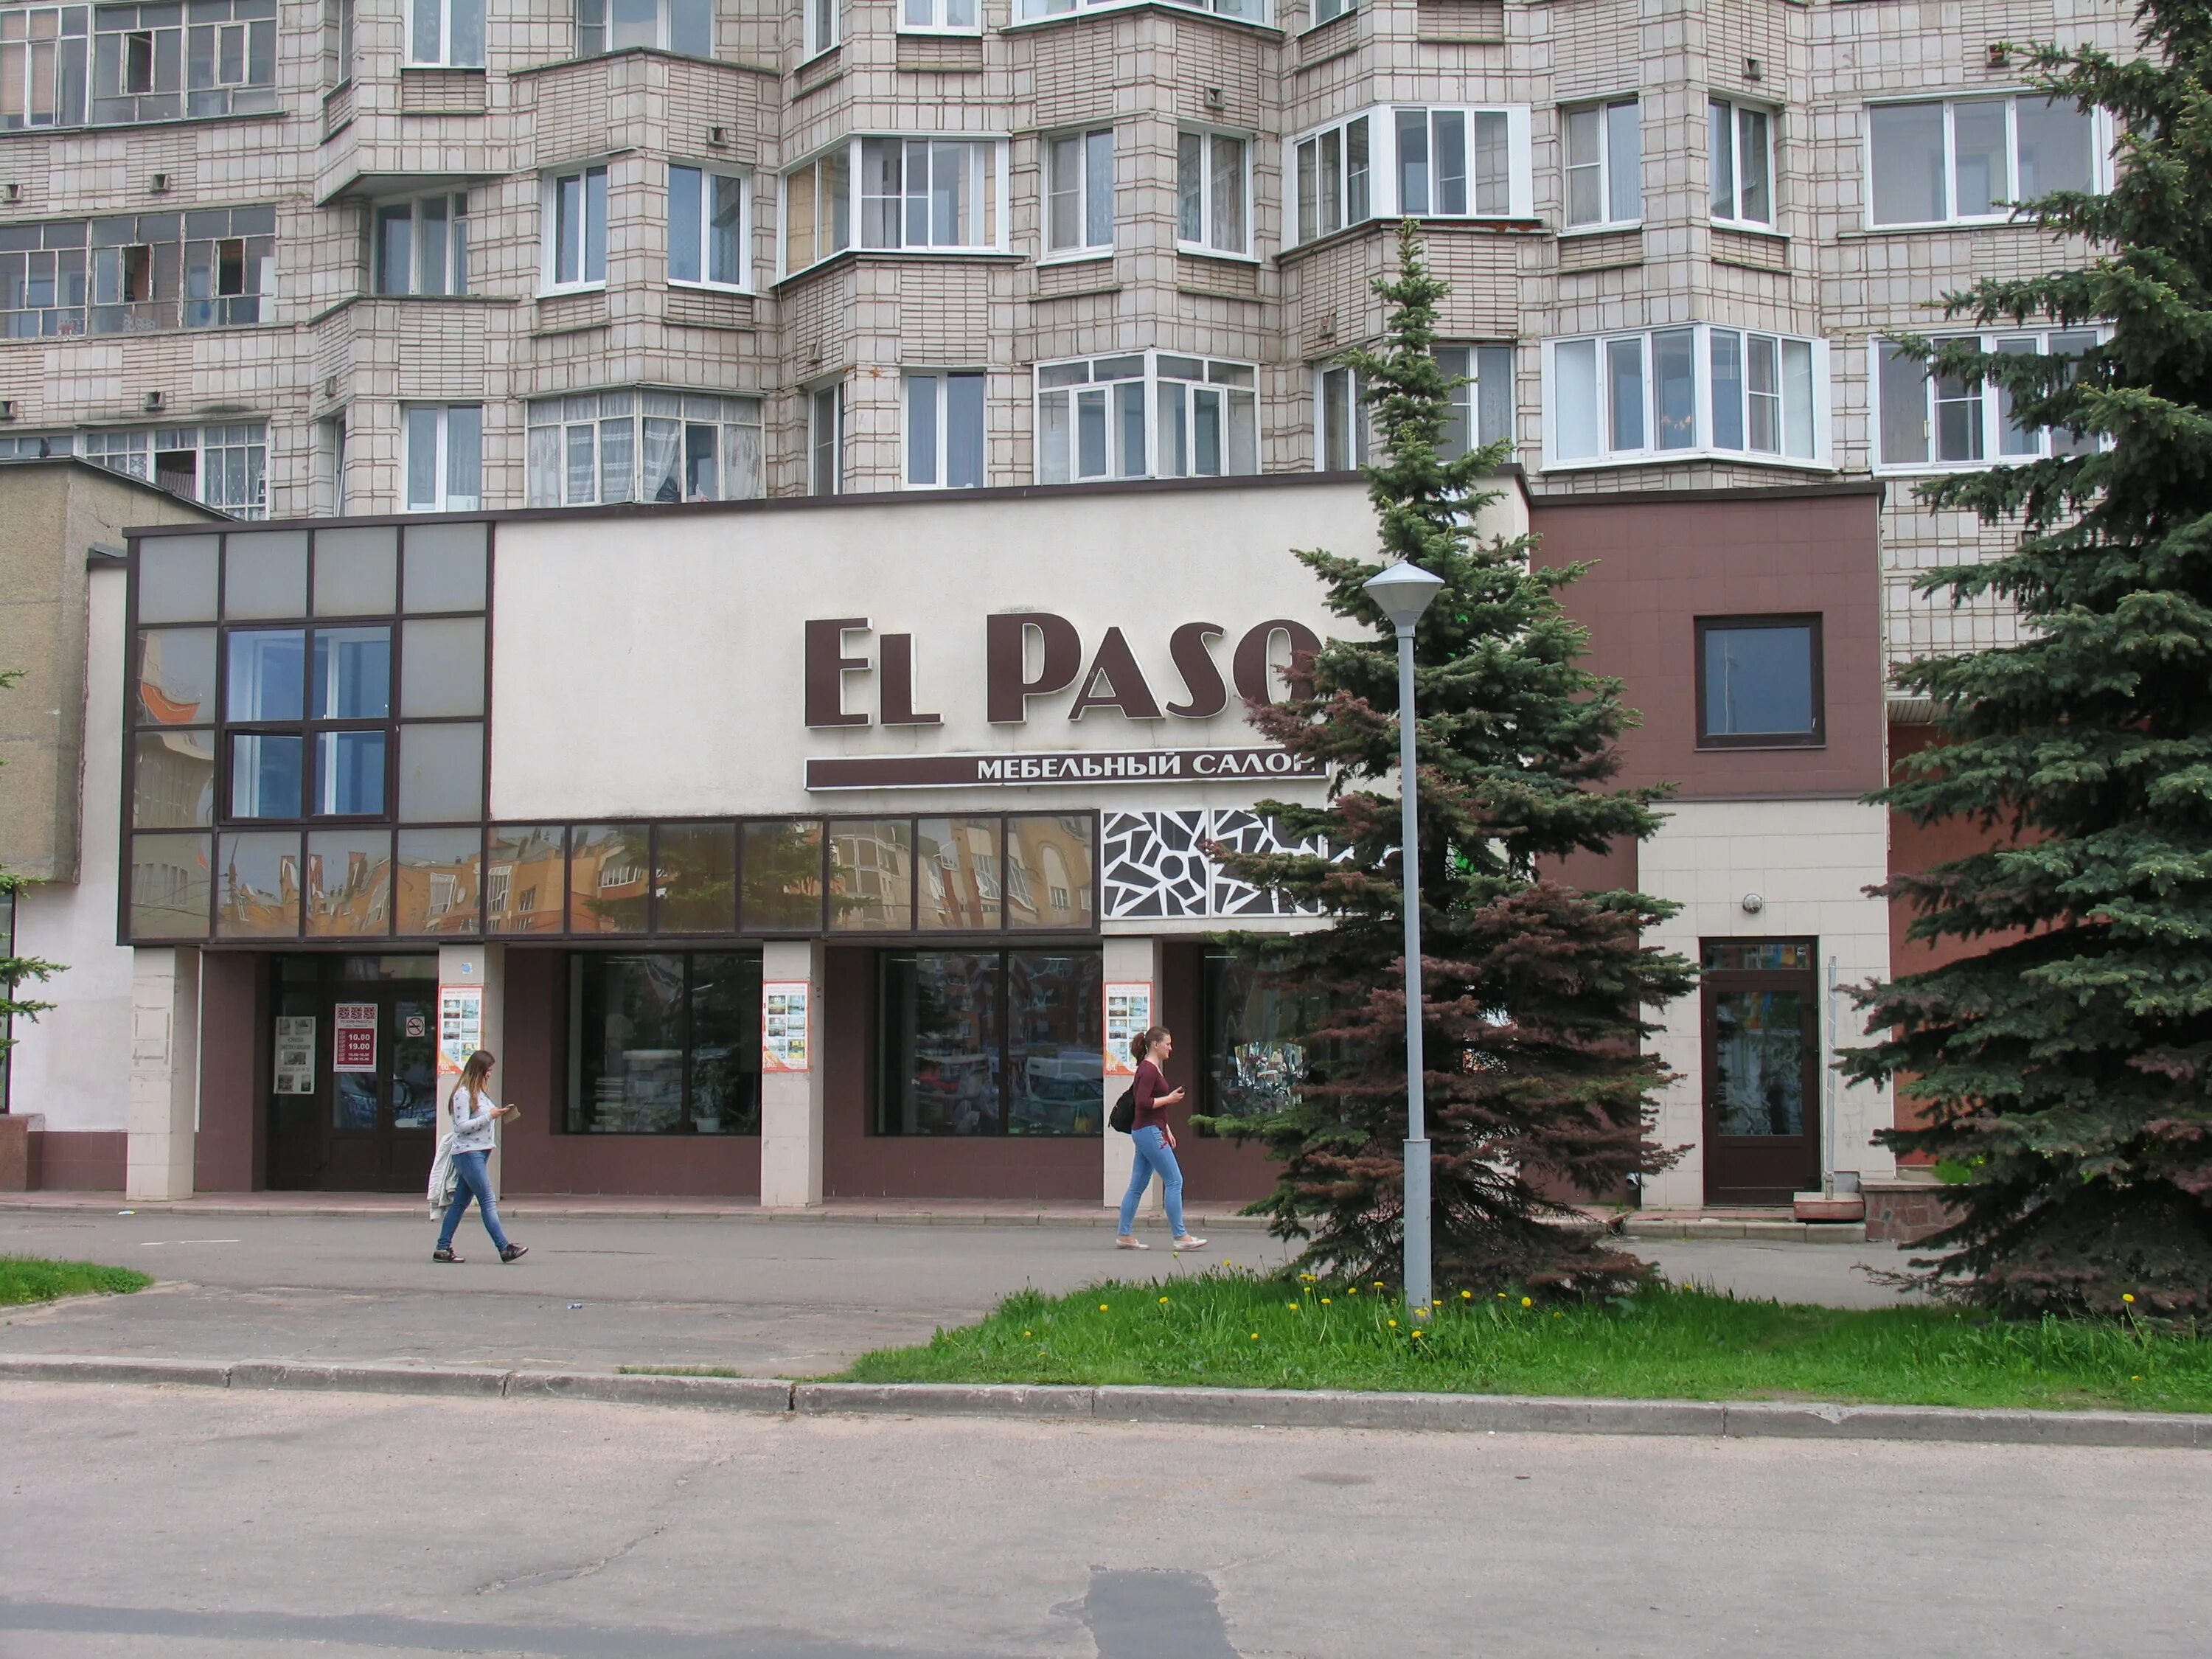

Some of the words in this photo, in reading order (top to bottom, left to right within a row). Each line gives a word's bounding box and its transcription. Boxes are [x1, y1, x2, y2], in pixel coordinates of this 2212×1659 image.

[804, 617, 944, 728] EL
[987, 612, 1327, 723] PASO
[978, 751, 1180, 779] МЕБЕЛЬНЫЙ
